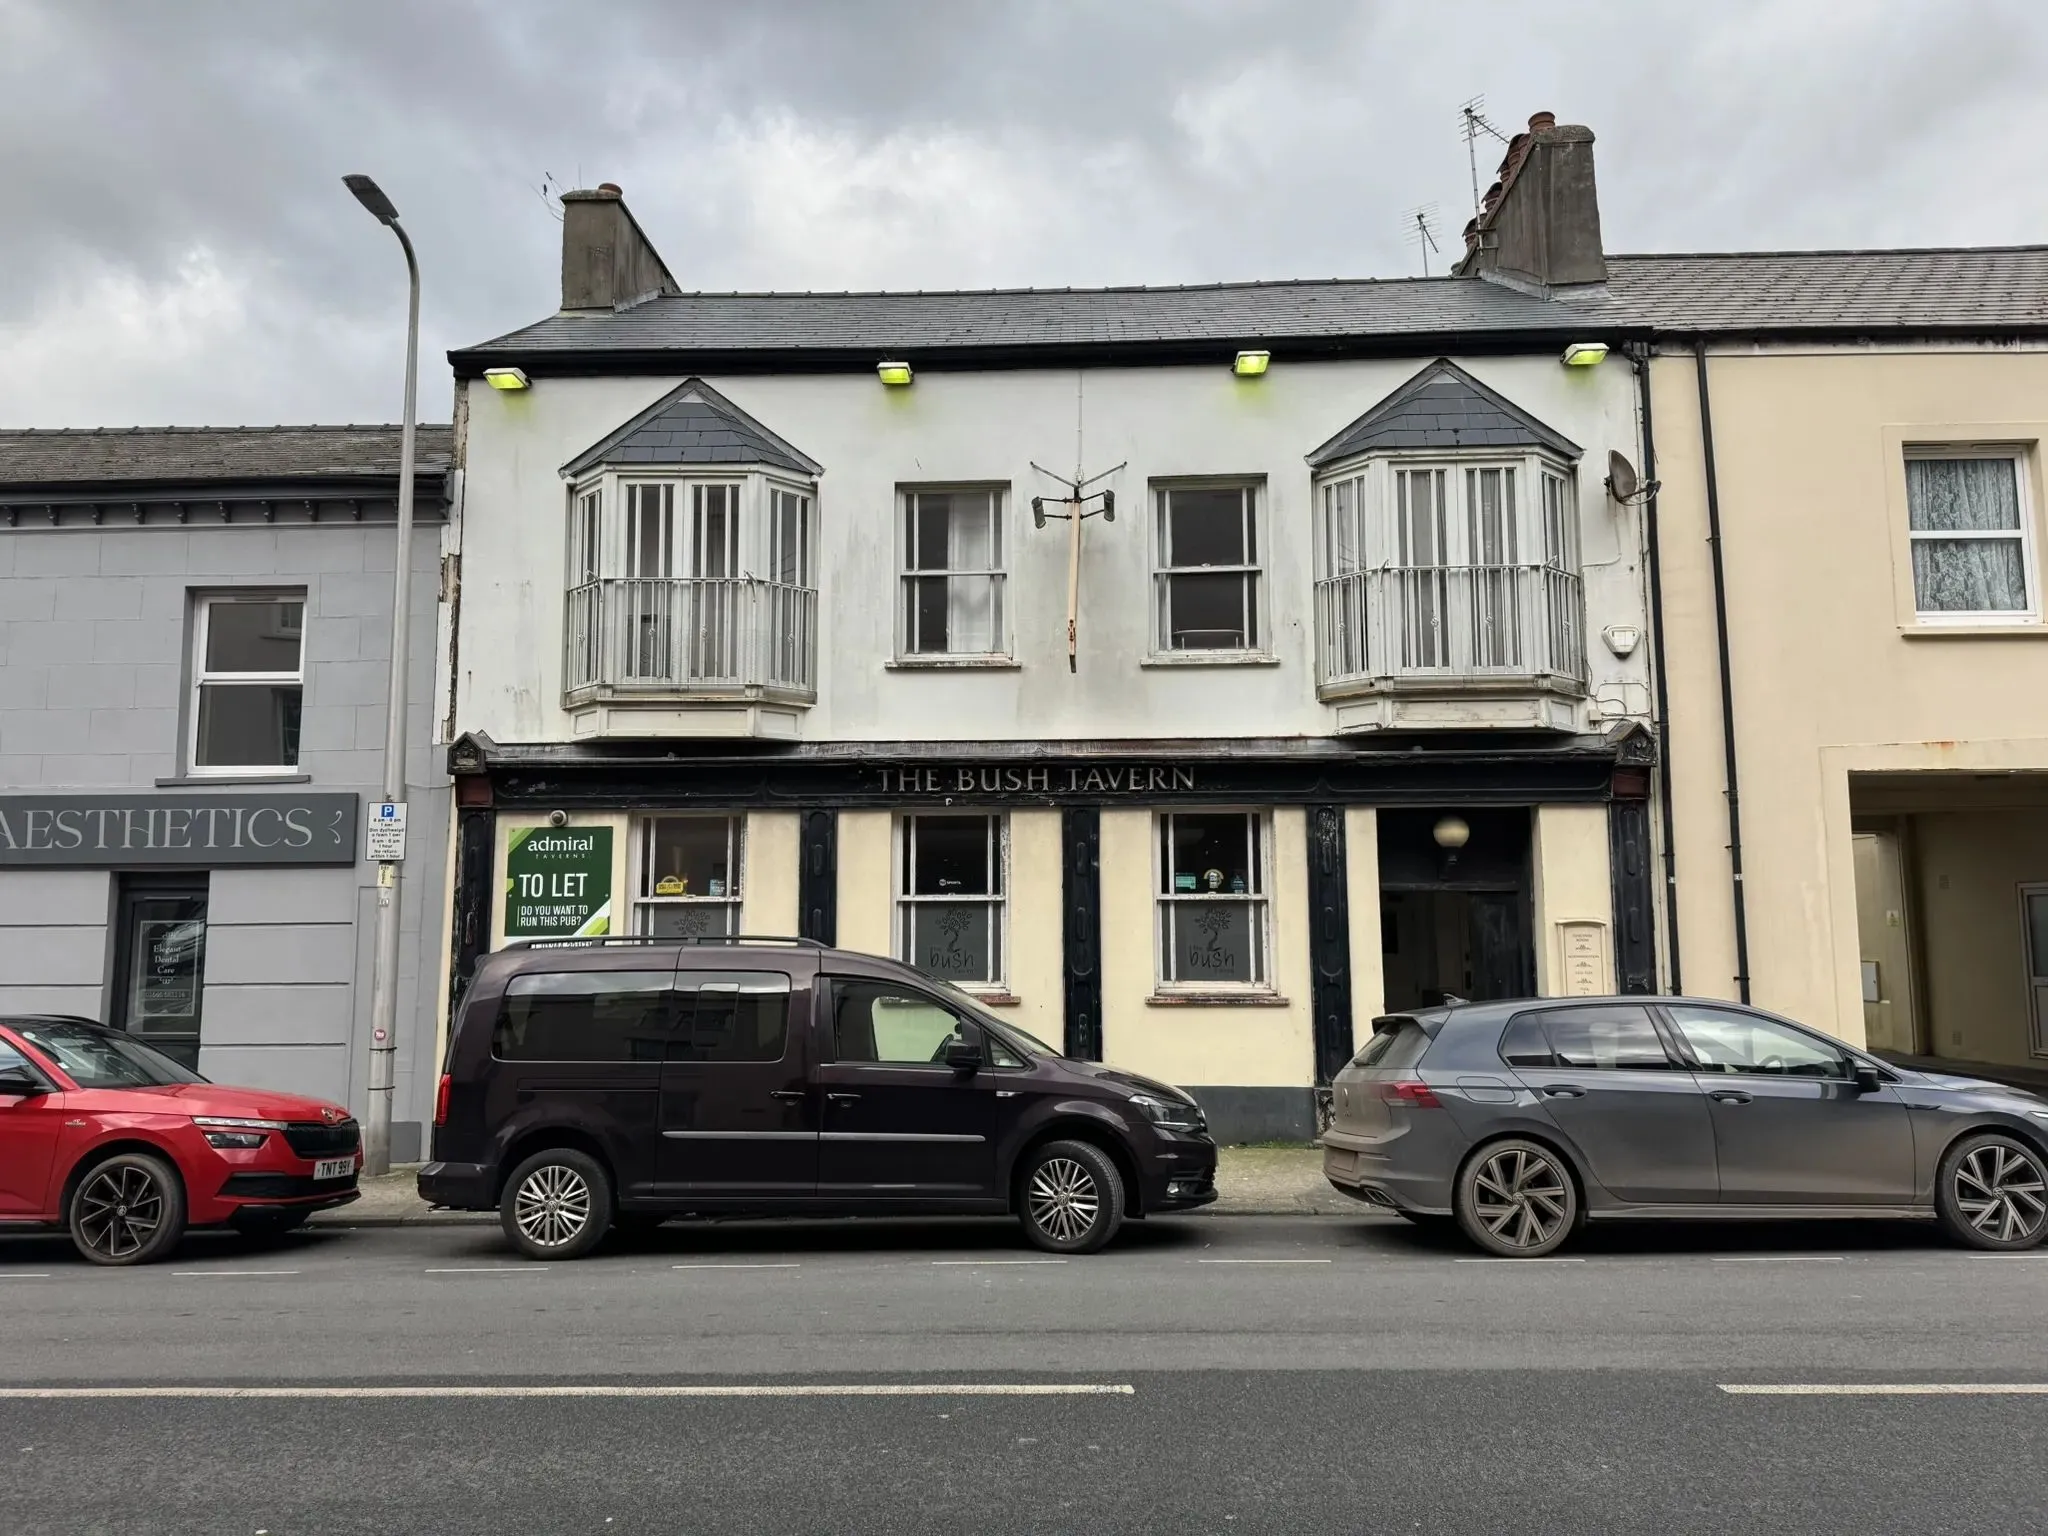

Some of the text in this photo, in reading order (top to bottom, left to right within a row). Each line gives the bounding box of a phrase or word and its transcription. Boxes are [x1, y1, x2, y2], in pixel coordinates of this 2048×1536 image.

[877, 767, 1195, 792] THE BUSH TAVERN
[384, 806, 393, 817] P
[527, 835, 593, 851] admiral
[519, 873, 588, 897] TO LET
[521, 905, 588, 916] DO YOU WANT TO
[520, 916, 582, 927] RUN THIS PUB?
[153, 944, 181, 954] Elegant
[155, 955, 179, 963] Dental
[930, 946, 974, 968] bush
[1189, 945, 1234, 968] bush
[157, 965, 175, 974] Care
[322, 1161, 337, 1176] TNT
